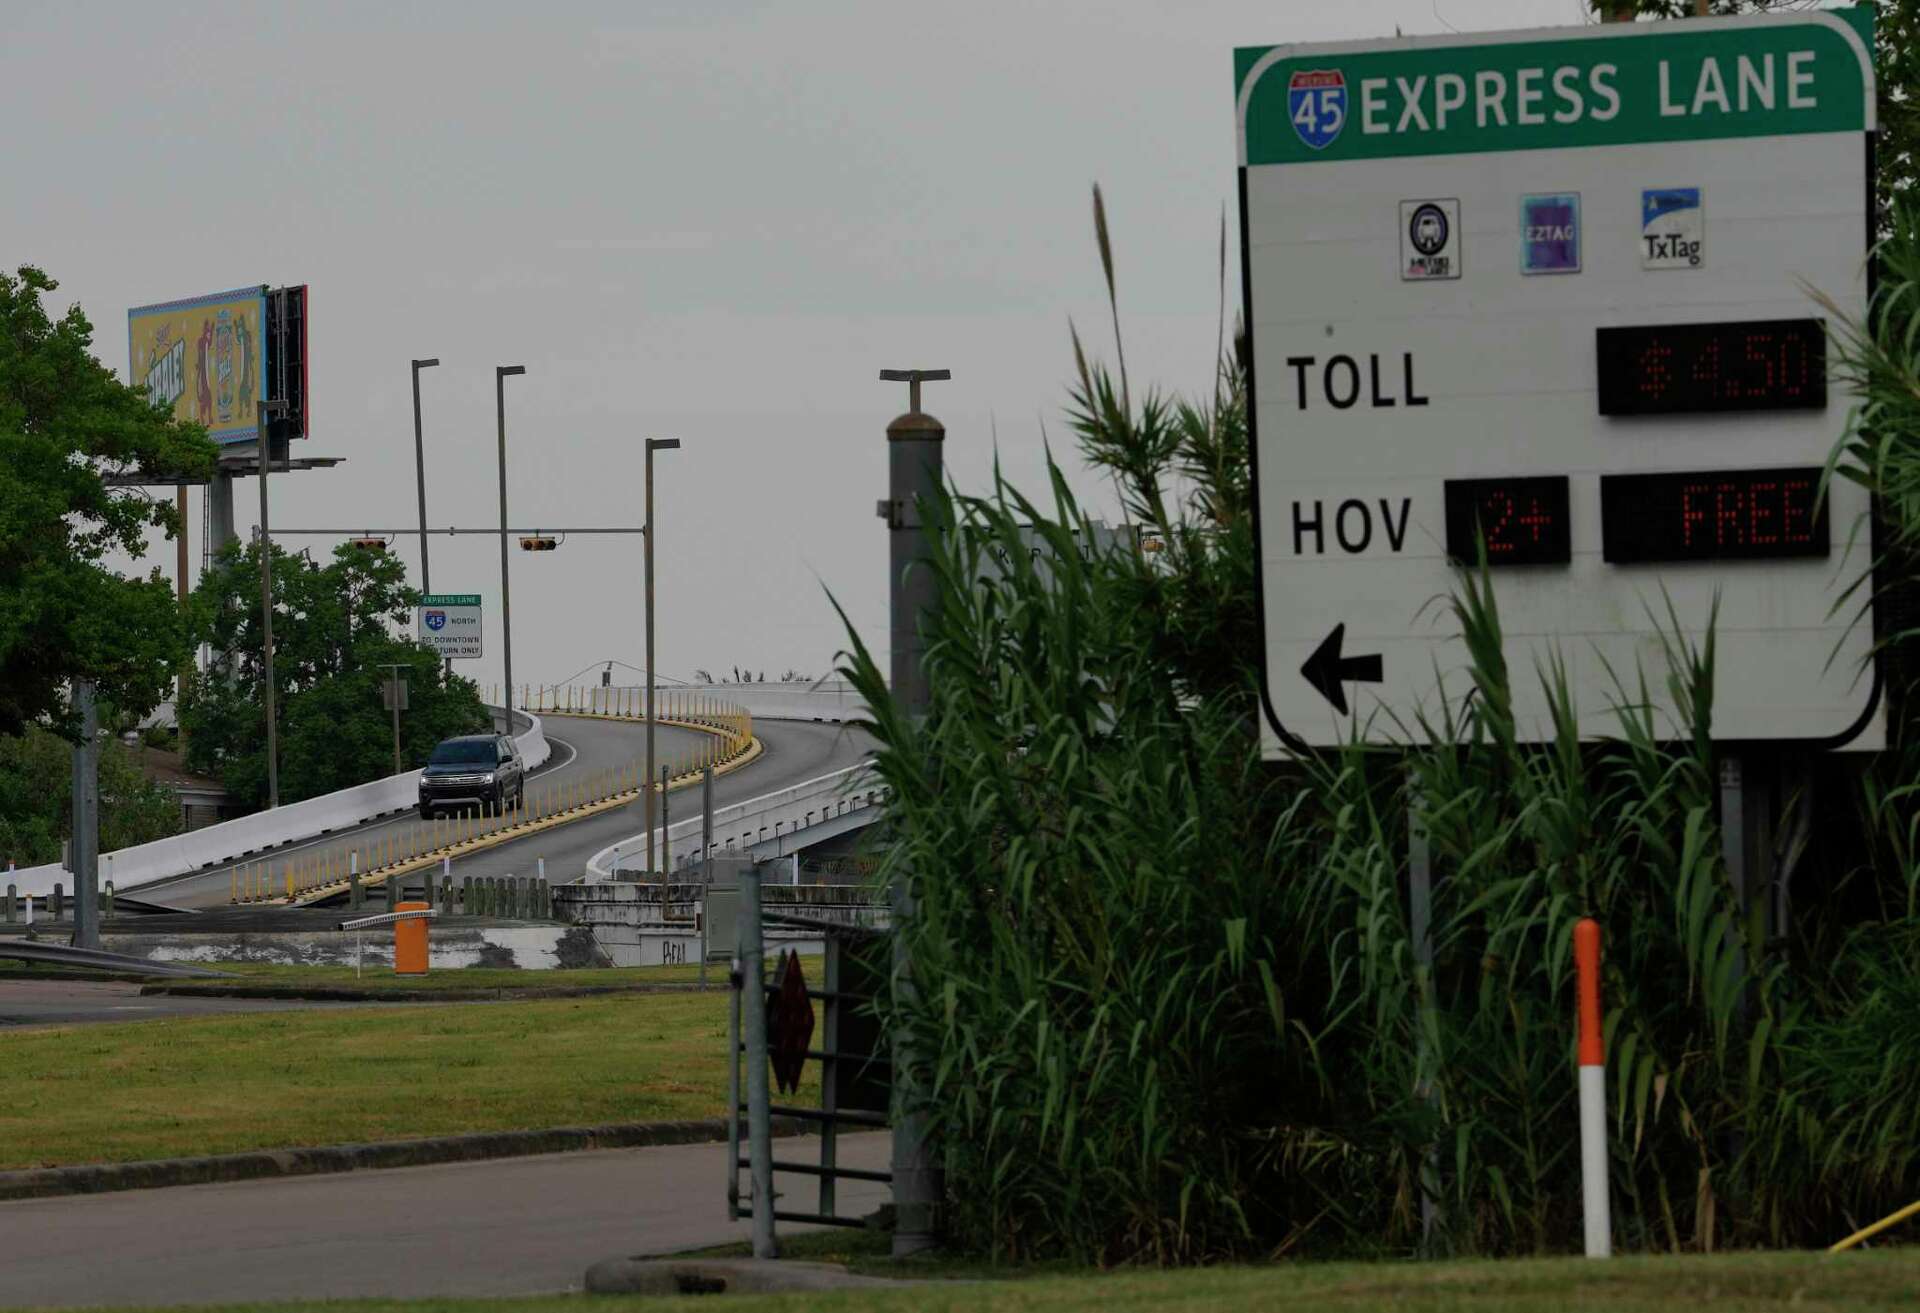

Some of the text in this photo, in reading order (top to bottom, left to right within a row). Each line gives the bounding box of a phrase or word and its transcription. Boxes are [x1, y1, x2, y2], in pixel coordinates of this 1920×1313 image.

[1360, 50, 1818, 135] EXPRESS LANE
[1294, 90, 1342, 134] 45
[1526, 224, 1574, 241] EZTAG
[1643, 234, 1701, 266] TxTag
[1287, 352, 1430, 411] TOLL
[1292, 496, 1412, 556] HOV
[1486, 480, 1812, 552] 2+ FREE
[422, 595, 477, 604] EXPRESS LANE
[427, 616, 443, 627] 45
[451, 617, 477, 625] NORTH
[434, 636, 480, 644] DOWNTOWN
[460, 647, 480, 655] ONLY
